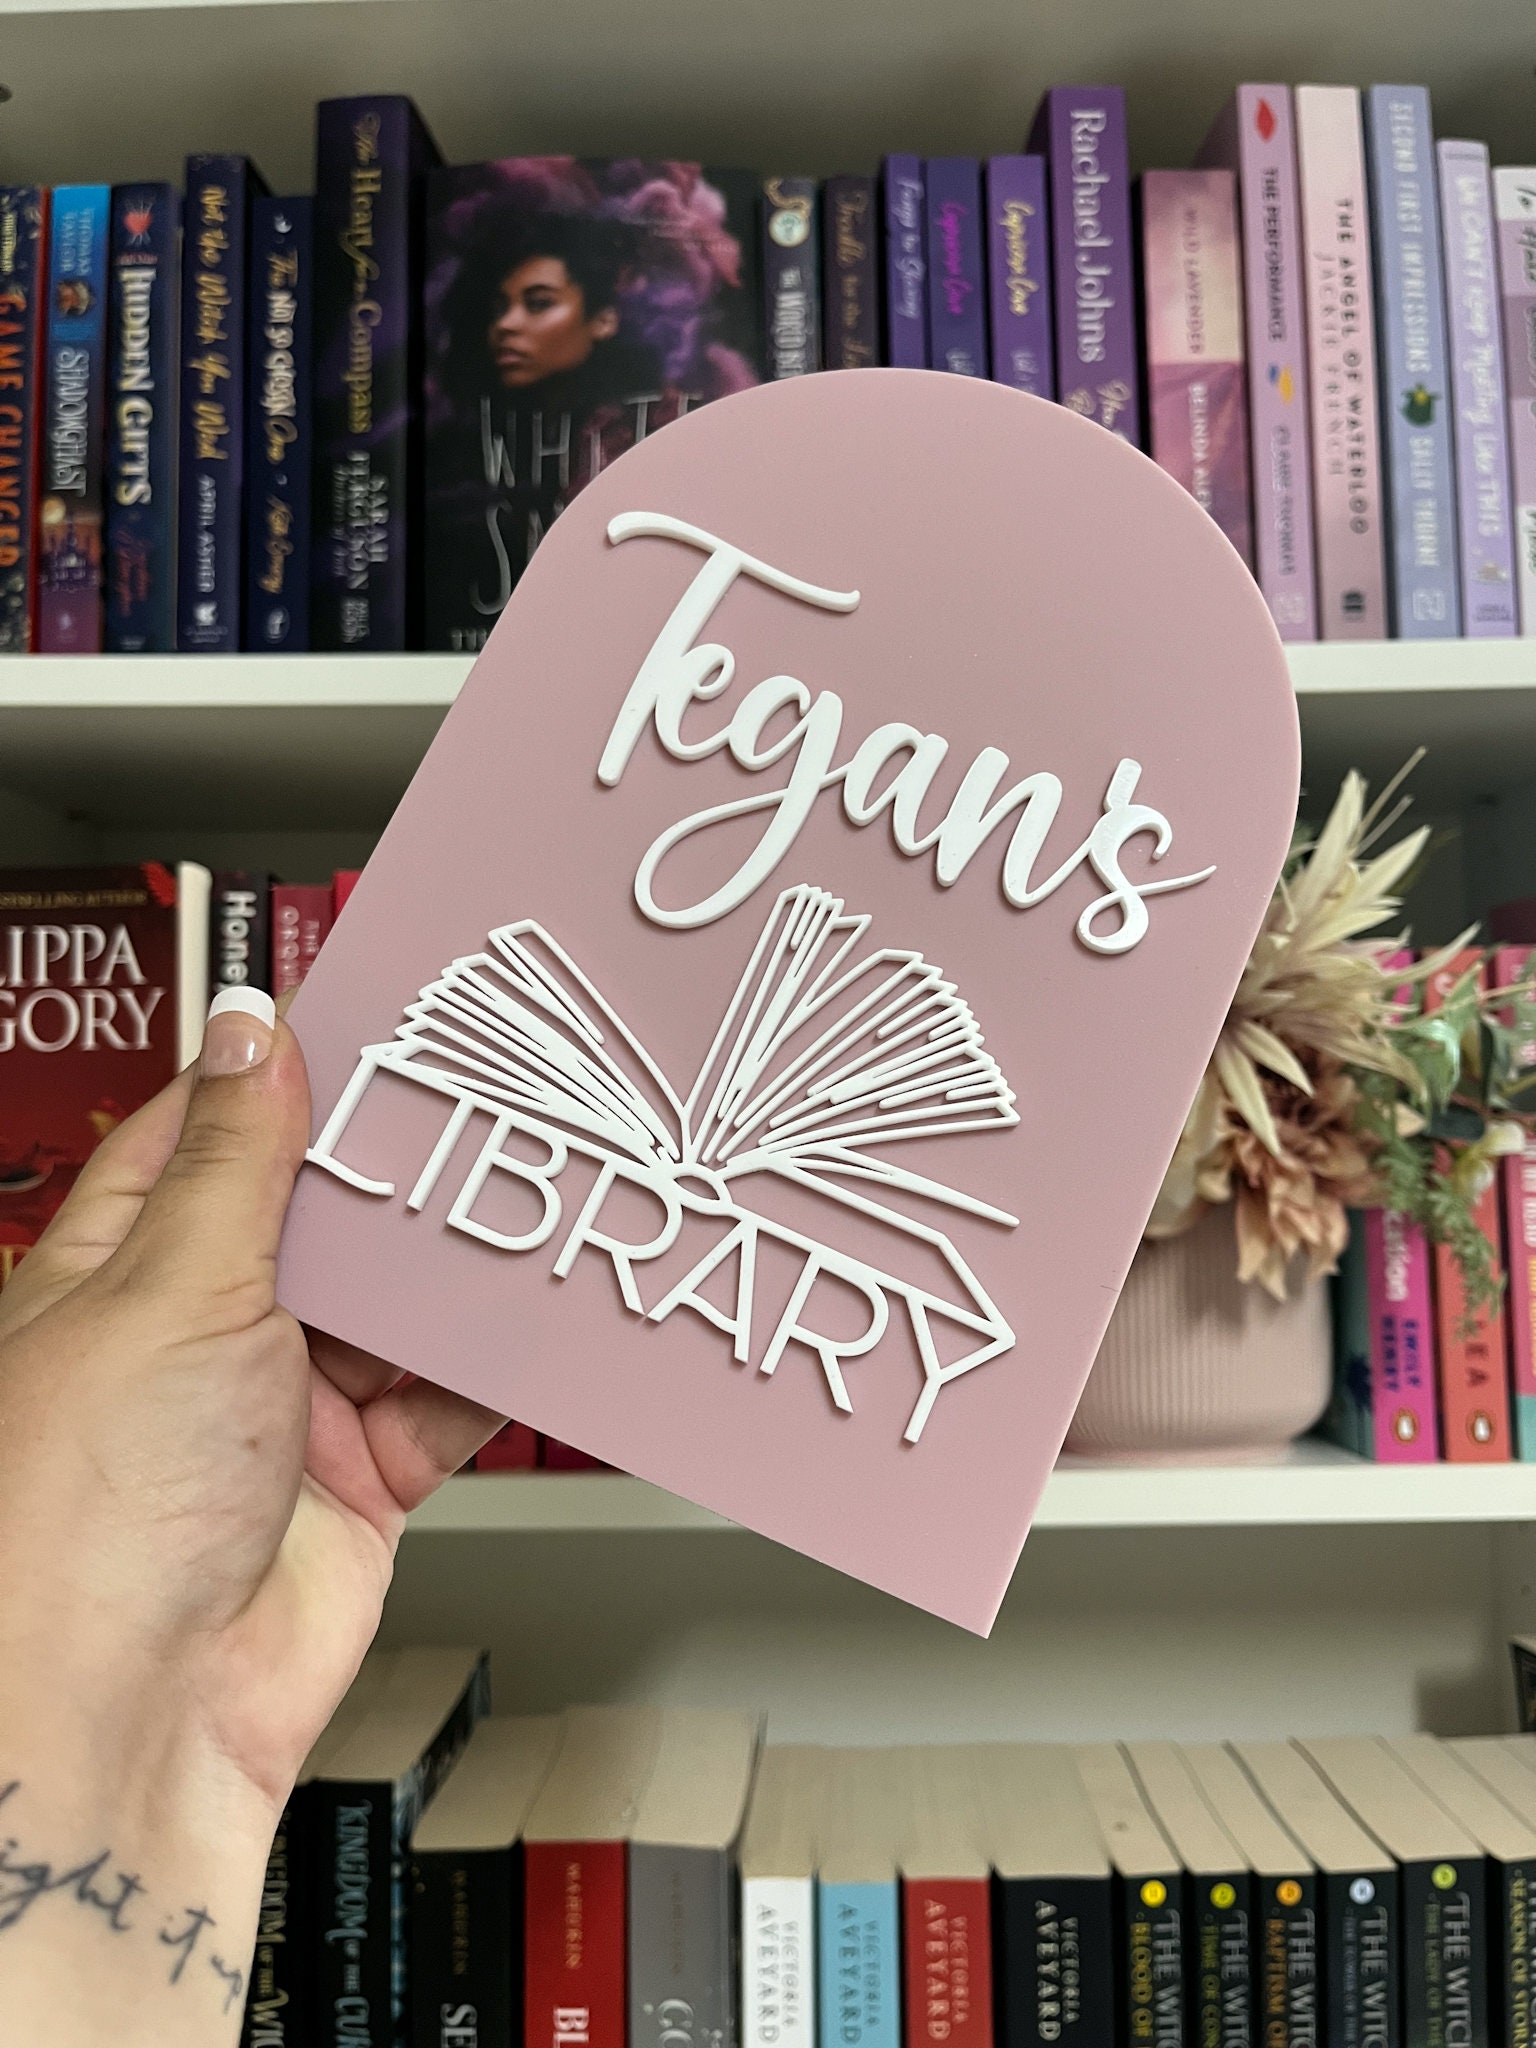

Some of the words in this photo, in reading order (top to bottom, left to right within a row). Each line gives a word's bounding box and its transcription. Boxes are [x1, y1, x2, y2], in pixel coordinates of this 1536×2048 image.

[1069, 110, 1114, 248] Rachael
[1263, 168, 1280, 201] THE
[1389, 102, 1417, 173] SECOND
[1336, 198, 1356, 244] THE
[1395, 181, 1423, 233] FIRST
[1073, 256, 1116, 363] Johns
[1264, 205, 1289, 343] PERFORMANCE
[1313, 251, 1338, 349] JACKIE
[1338, 256, 1361, 339] ANGEL
[1400, 242, 1432, 372] IMPRESSIONS
[118, 266, 157, 392] HIDDEN
[341, 301, 383, 433] Compass
[1343, 350, 1364, 384] OF
[116, 397, 153, 506] GIFTS
[479, 394, 703, 490] WHIT
[1188, 382, 1209, 463] BELINDA
[1323, 364, 1345, 477] FRENCH
[1346, 395, 1370, 535] WATERLOO
[346, 450, 371, 590] FERGUSON
[367, 475, 389, 563] SARAH
[599, 511, 1217, 955] Tegan's
[0, 924, 148, 987] IPPA
[216, 889, 259, 992] Hone
[305, 1044, 1017, 1444] LIBRARY
[325, 1800, 373, 1945] KINGDOM
[1510, 1878, 1529, 1954] SEASON
[757, 1903, 781, 2043] AVEYARD
[837, 1903, 862, 2043] AVEYARD
[925, 1899, 950, 2041] AVEYARD
[1034, 1900, 1061, 2041] AVEYARD
[1130, 1922, 1152, 2004] BLOOD
[1153, 1908, 1181, 1980] THE
[1221, 1909, 1249, 1980] THE
[1288, 1908, 1316, 1979] THE
[1361, 1905, 1388, 1976] THE
[1443, 1890, 1472, 1961] THE
[1511, 1957, 1528, 1983] OF
[1131, 2007, 1153, 2037] OF
